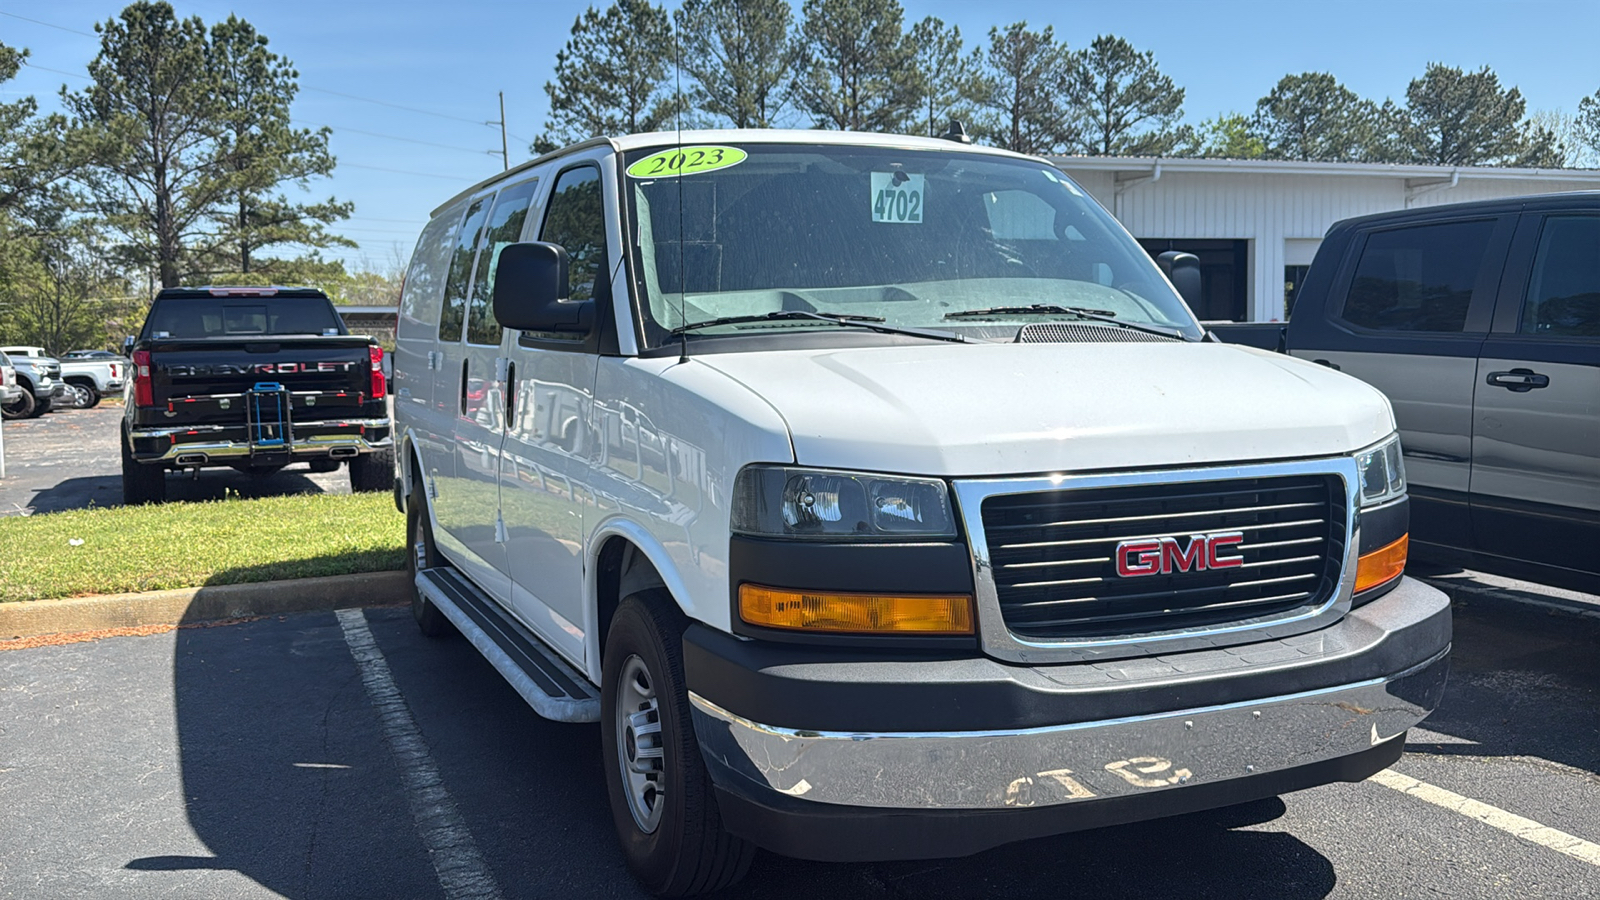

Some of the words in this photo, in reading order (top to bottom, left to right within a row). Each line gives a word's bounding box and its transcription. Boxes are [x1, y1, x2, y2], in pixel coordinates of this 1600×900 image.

[647, 149, 725, 175] 2023
[874, 189, 920, 221] 4702
[168, 361, 356, 377] CHEVROLET
[1116, 531, 1244, 577] GMC
